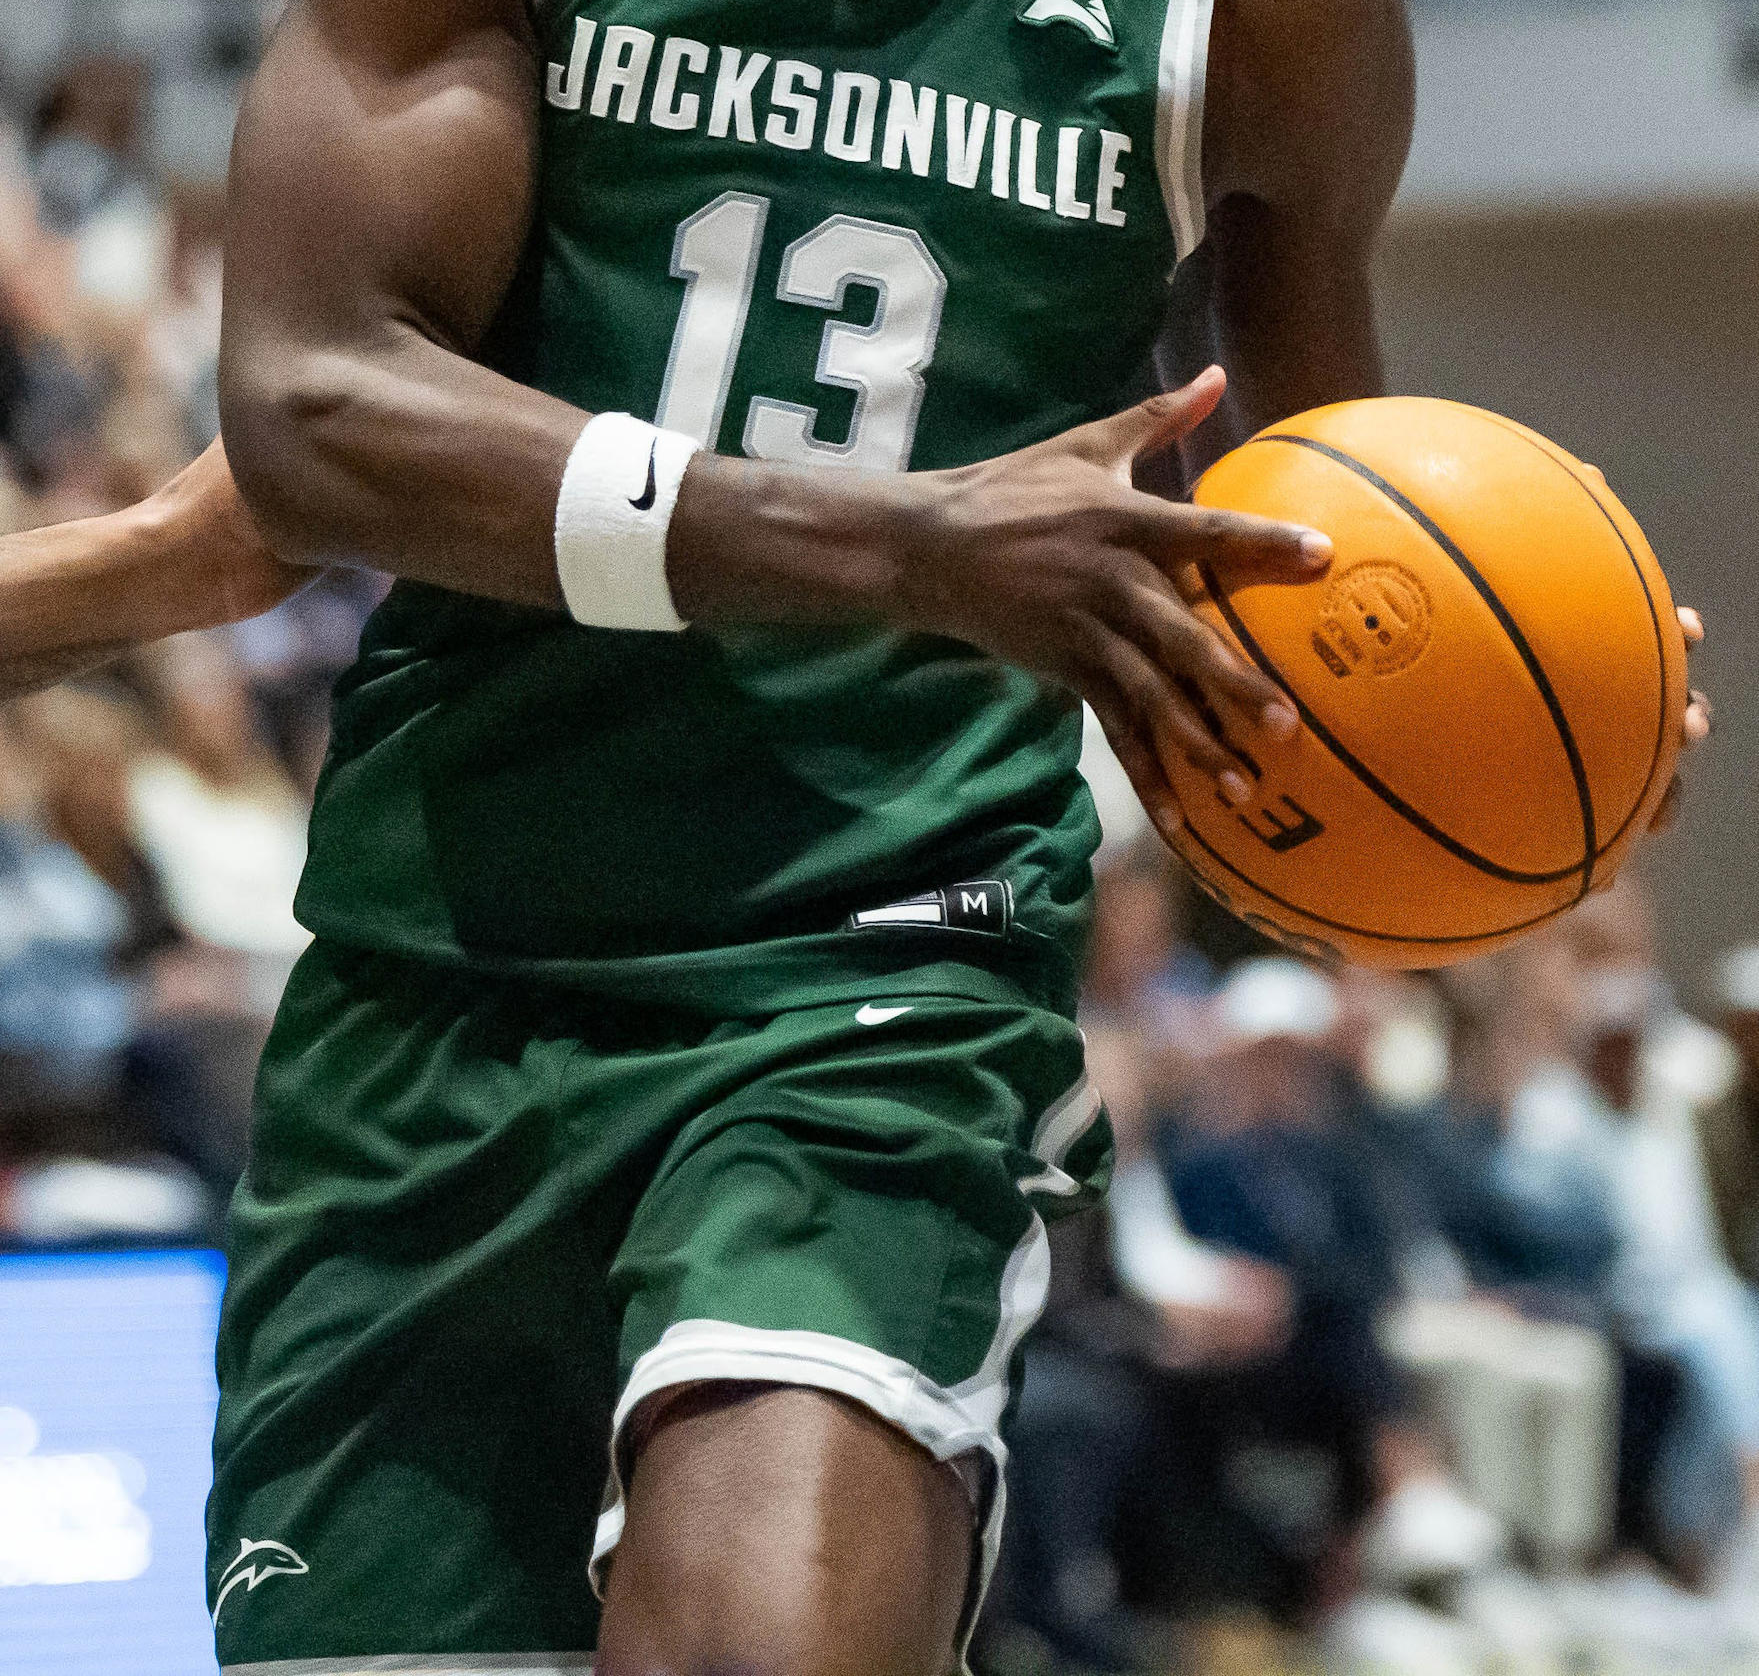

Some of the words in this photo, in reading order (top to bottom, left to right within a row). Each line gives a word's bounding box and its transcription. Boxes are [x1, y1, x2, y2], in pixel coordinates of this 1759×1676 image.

[546, 16, 1133, 227] JACKSONVILLE
[652, 190, 948, 473] 13
[960, 890, 988, 916] M
